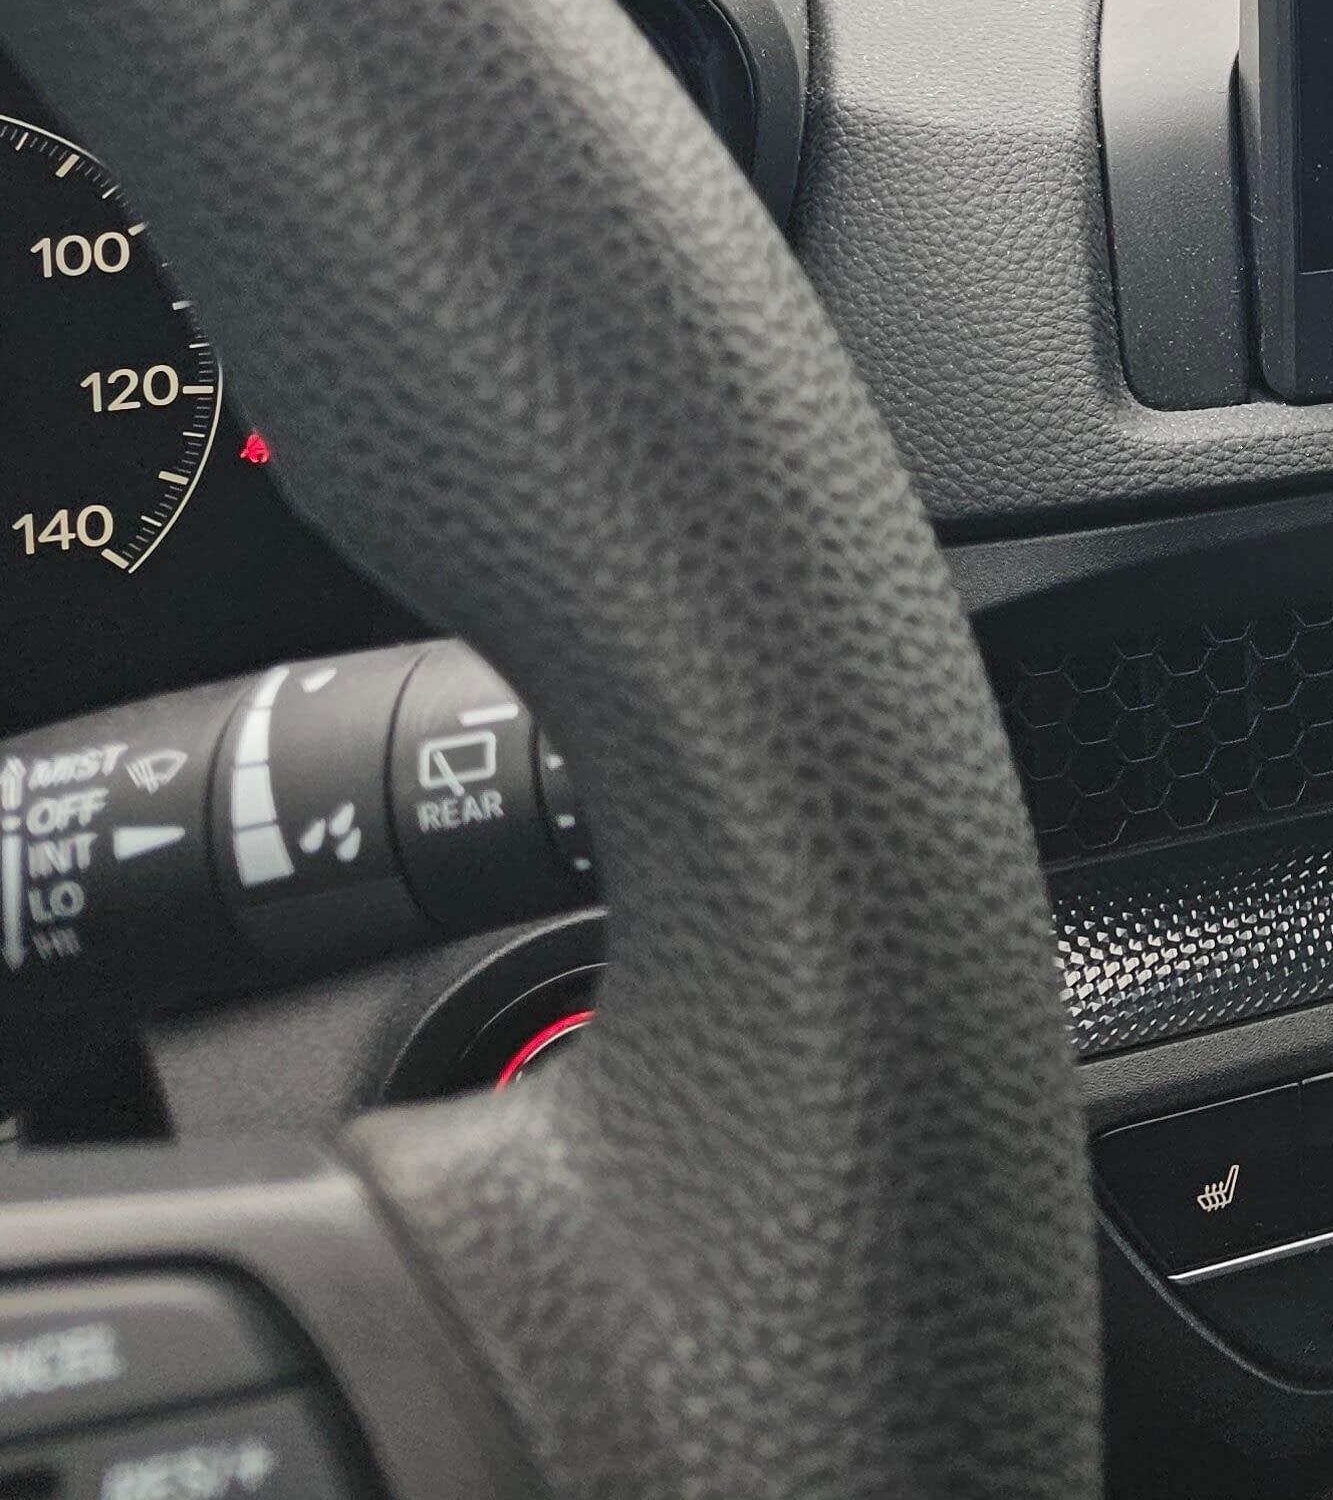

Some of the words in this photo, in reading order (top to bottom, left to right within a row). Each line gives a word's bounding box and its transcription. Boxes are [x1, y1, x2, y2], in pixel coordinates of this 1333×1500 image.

[30, 231, 131, 279] 100
[79, 364, 180, 413] 120
[12, 504, 115, 556] 140
[26, 788, 110, 835] OFF
[417, 789, 505, 834] REAR
[28, 832, 98, 879] INT
[28, 880, 85, 923] LO
